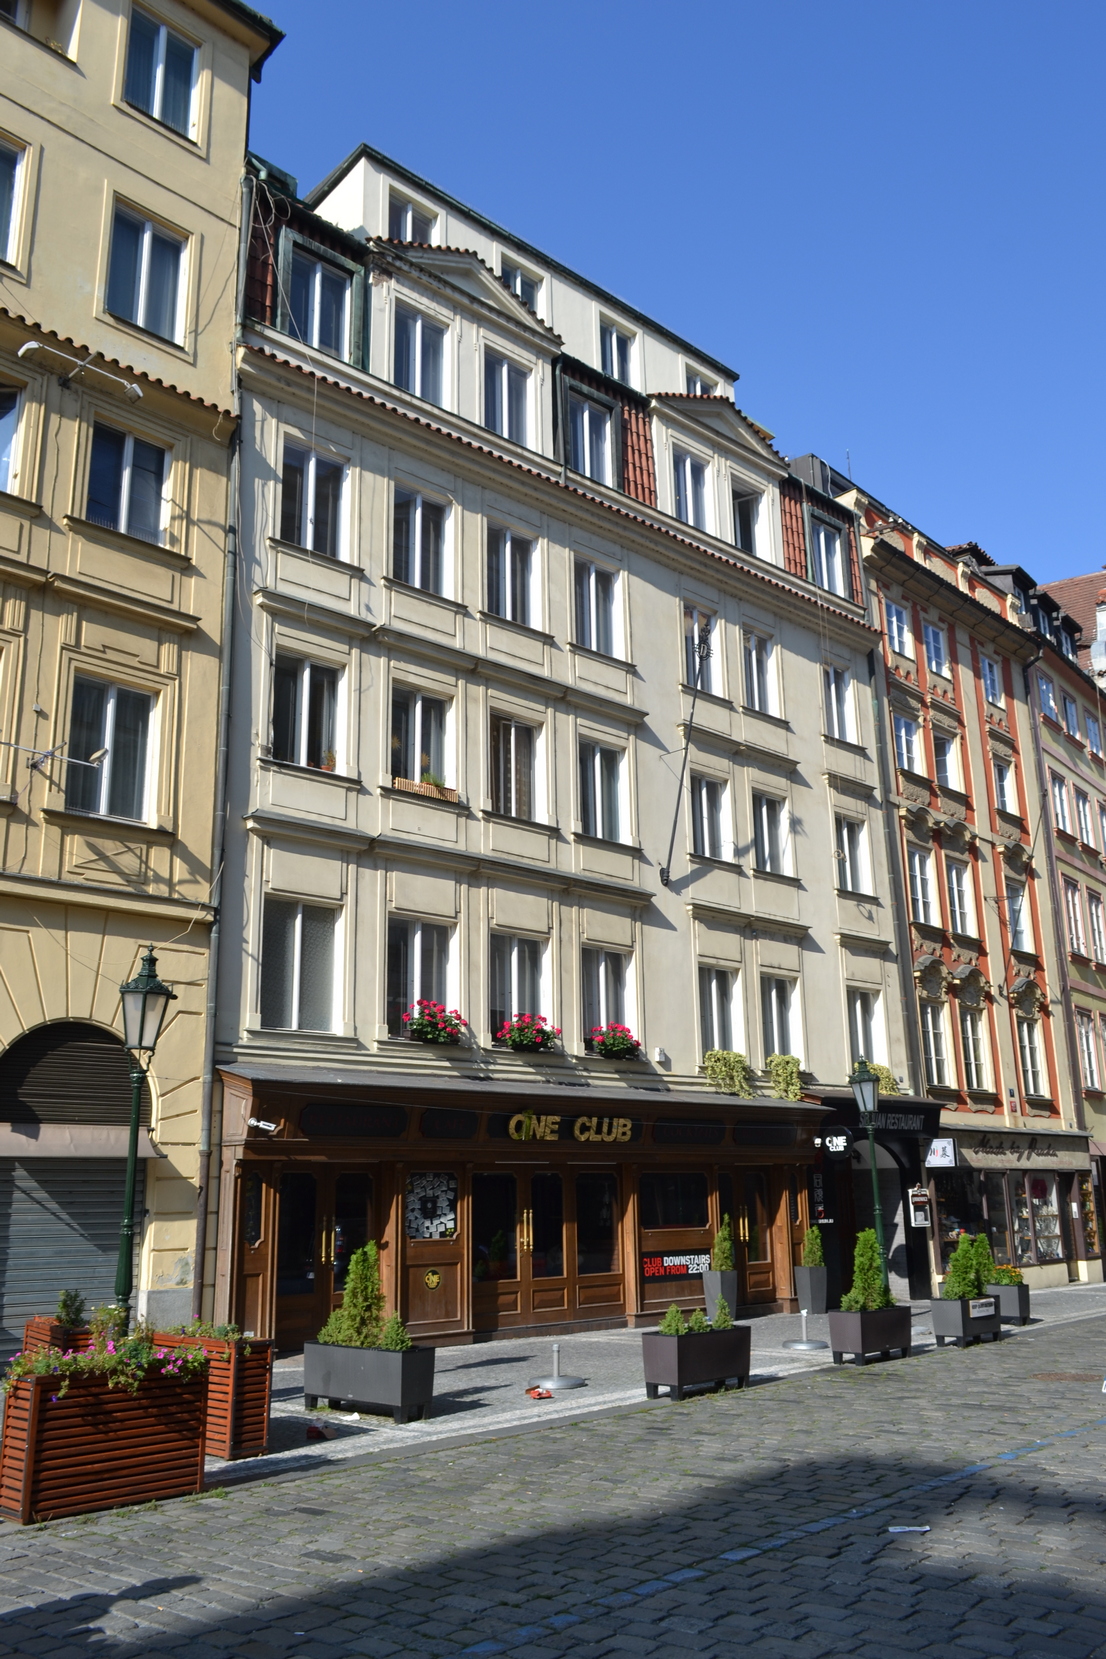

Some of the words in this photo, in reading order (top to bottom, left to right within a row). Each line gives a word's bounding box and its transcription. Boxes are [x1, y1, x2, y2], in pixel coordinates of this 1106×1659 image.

[508, 1113, 562, 1141] ONE
[573, 1116, 633, 1142] CLUB
[886, 1113, 925, 1131] RESTAURANT
[825, 1135, 847, 1147] ONE
[642, 1257, 663, 1268] CLUB
[663, 1254, 711, 1267] DOWNSTAIRS
[644, 1266, 665, 1277] OPEN
[666, 1264, 688, 1275] FROM
[688, 1263, 710, 1274] 22:00
